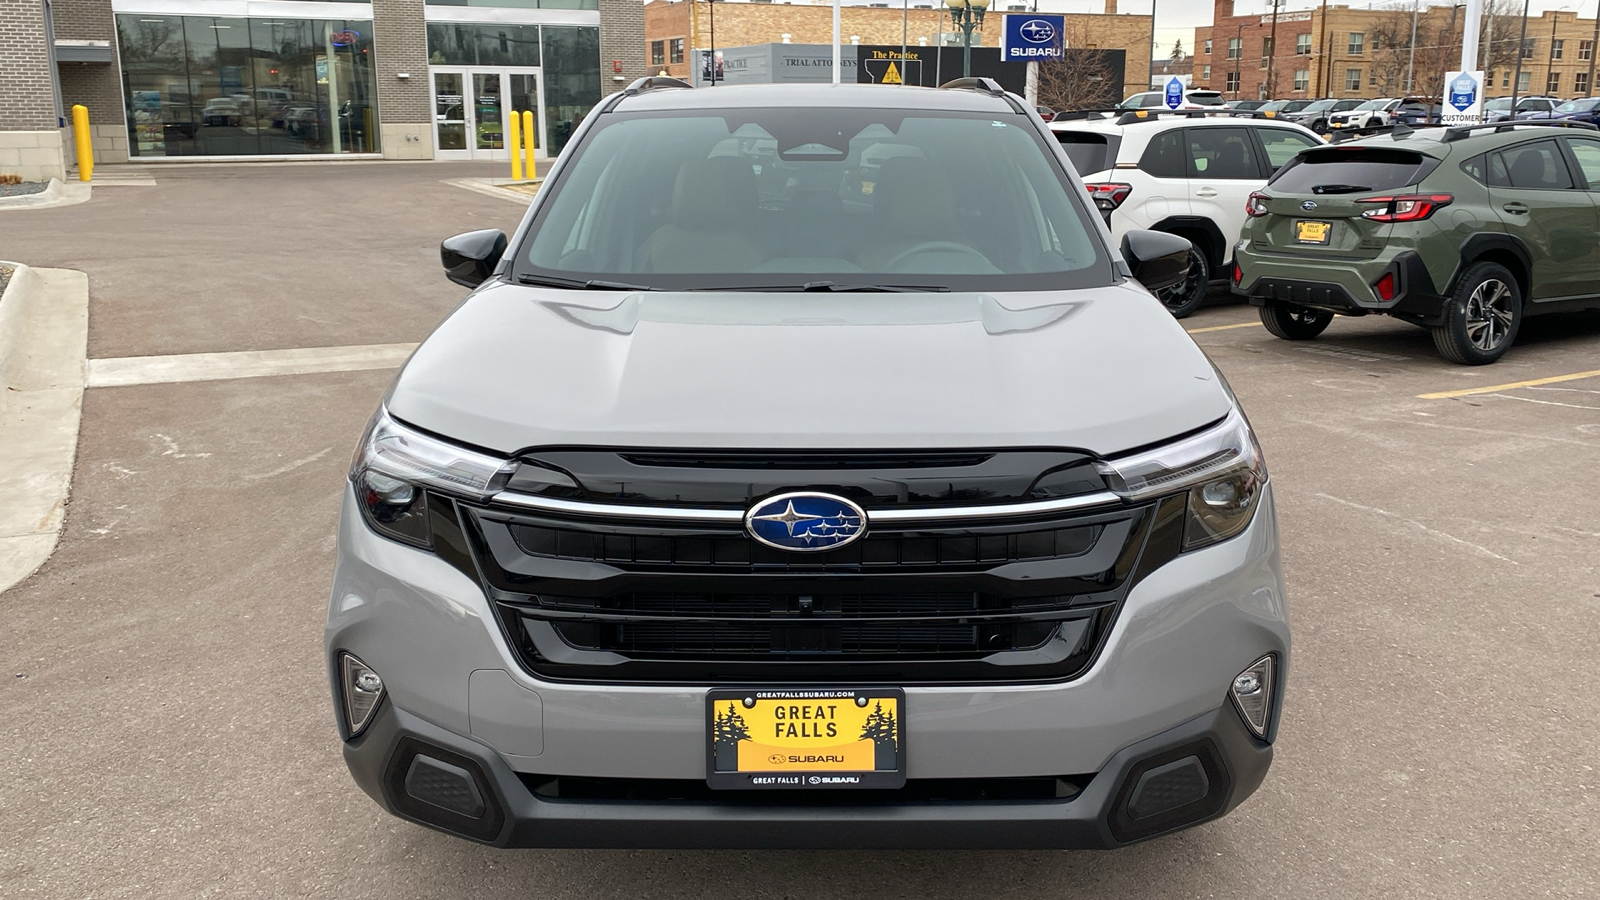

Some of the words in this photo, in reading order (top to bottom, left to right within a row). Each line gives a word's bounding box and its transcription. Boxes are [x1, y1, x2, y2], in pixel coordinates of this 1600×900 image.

[330, 32, 357, 44] OPEN
[871, 51, 887, 59] The
[888, 51, 919, 60] Pratice
[1010, 47, 1061, 57] SUBARU
[785, 59, 810, 67] TRIAL
[811, 59, 857, 67] ATTONEYS
[774, 705, 837, 720] GREAT
[775, 722, 837, 738] FALLS
[788, 755, 844, 763] SUBARU
[777, 776, 799, 784] FALLS
